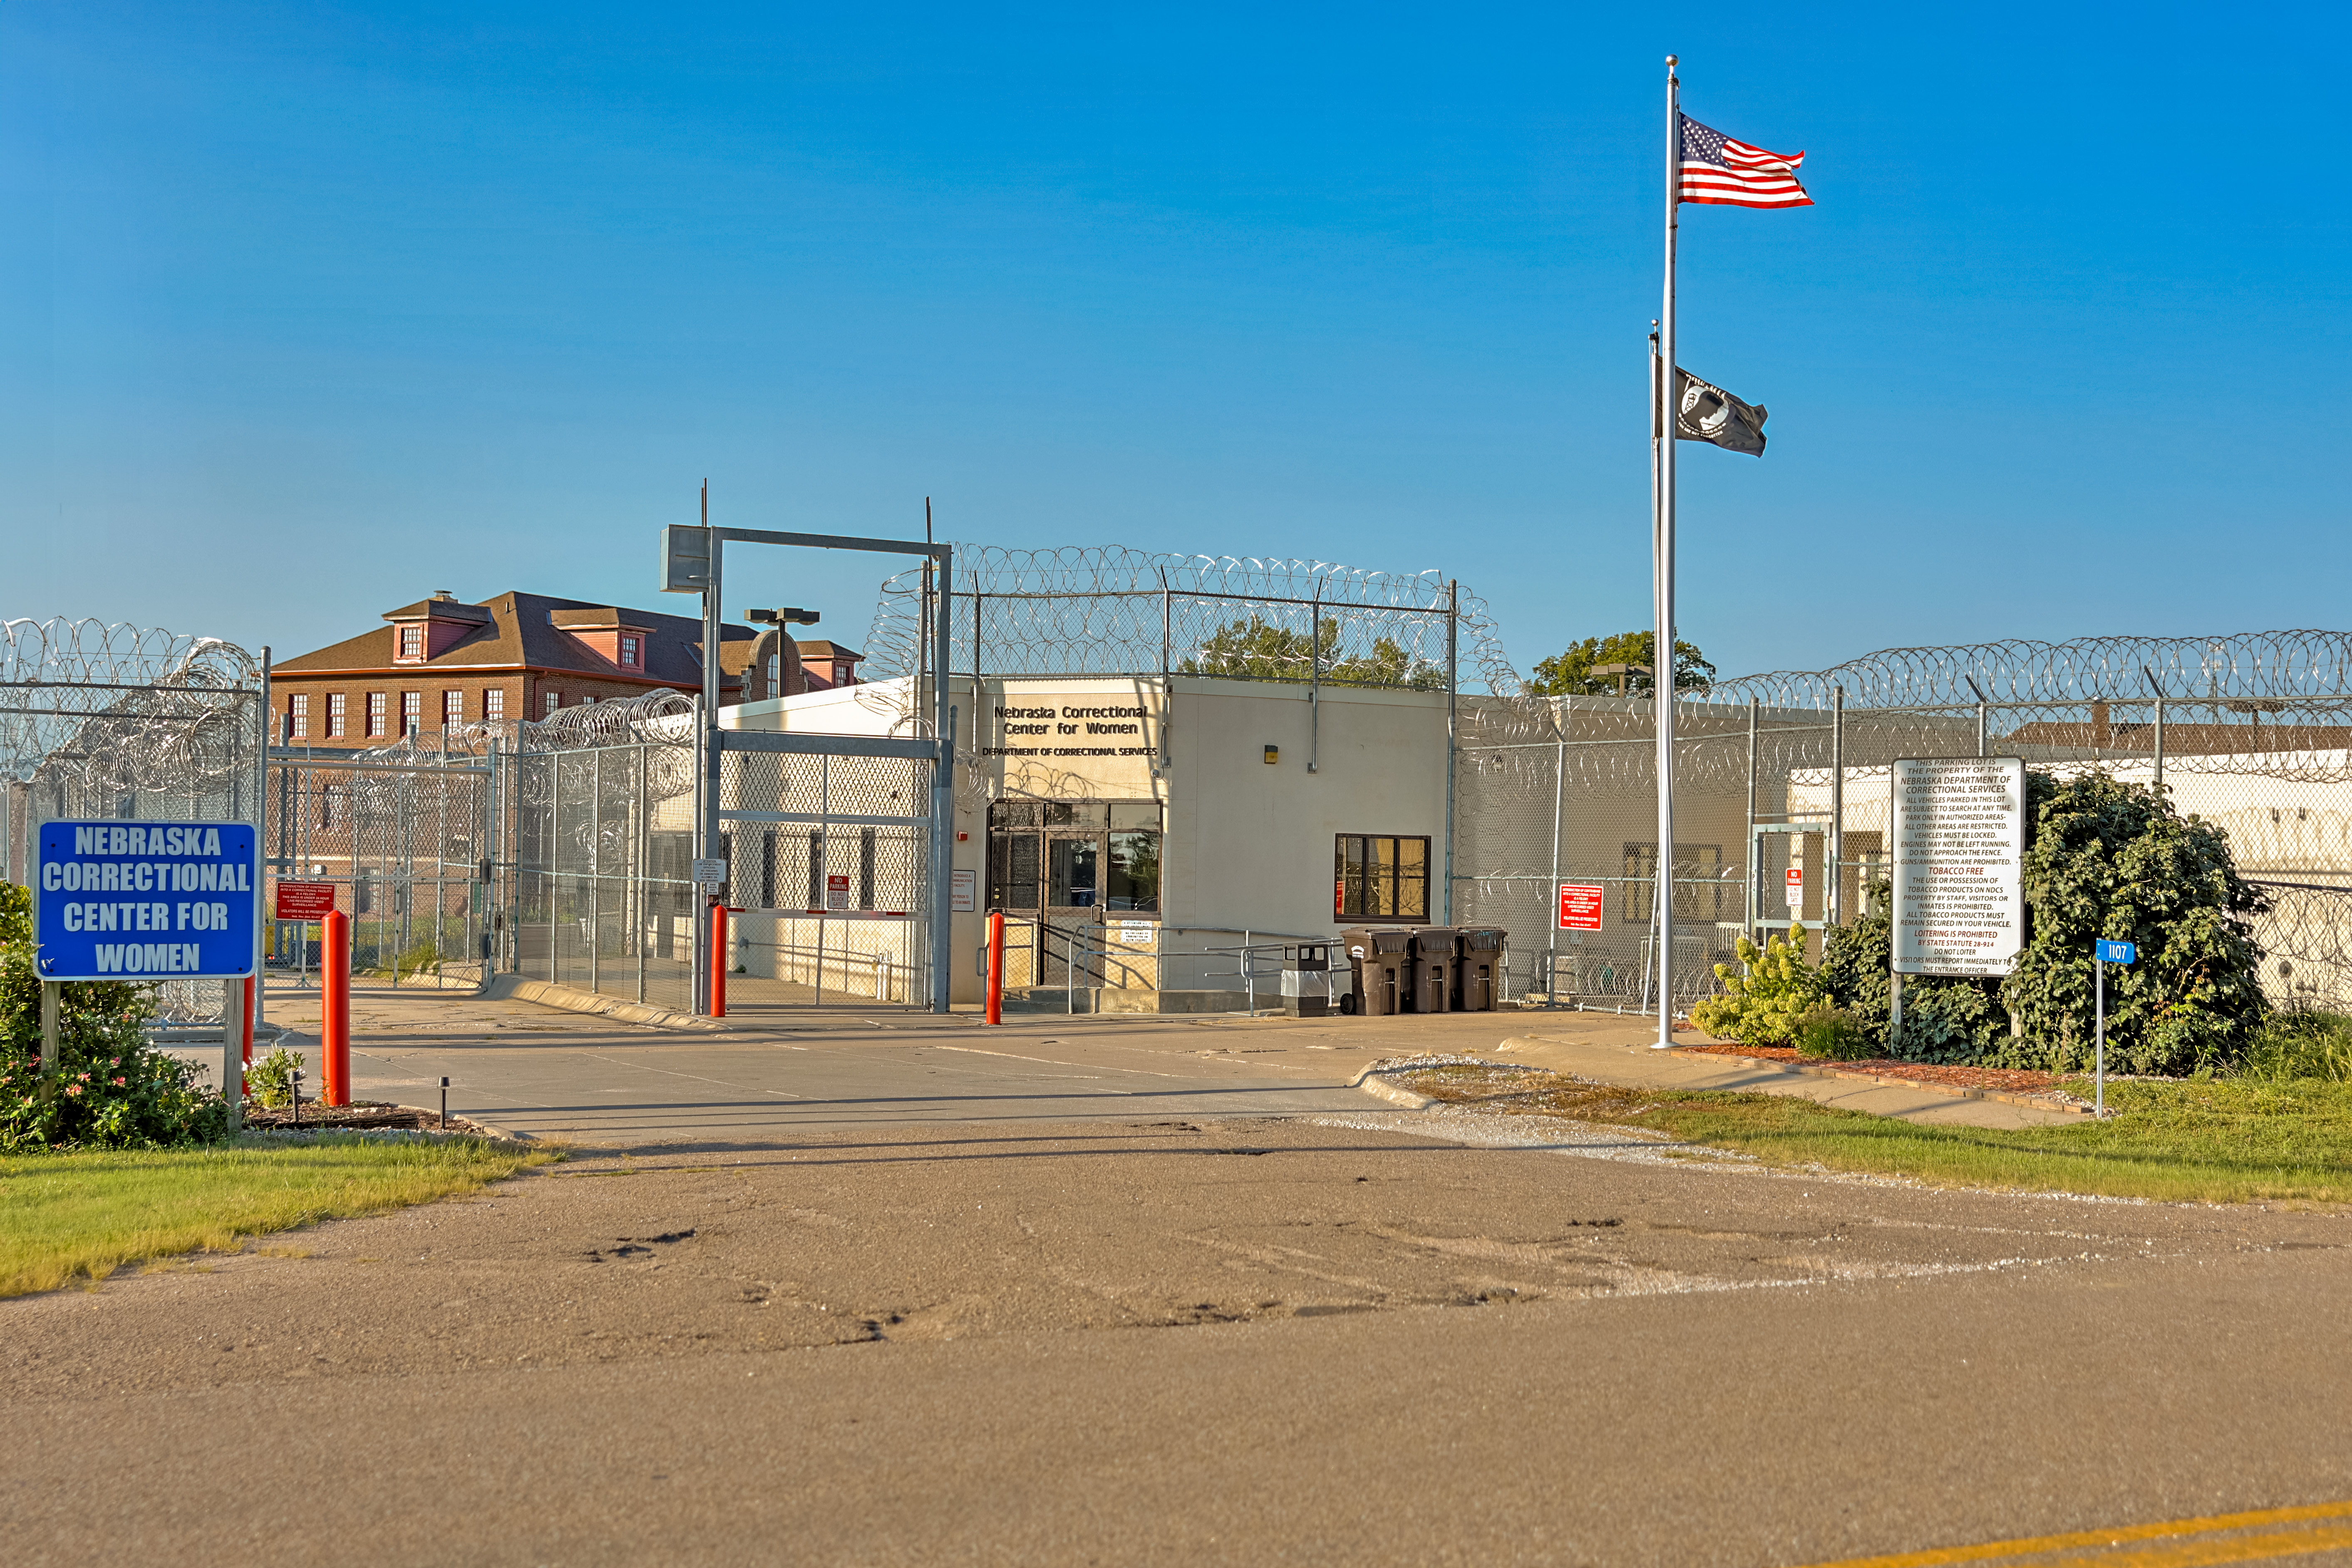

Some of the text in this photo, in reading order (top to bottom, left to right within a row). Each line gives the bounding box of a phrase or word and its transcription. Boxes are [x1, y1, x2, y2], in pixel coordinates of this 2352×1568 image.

[995, 705, 1148, 719] Nebraska Correctional
[1003, 722, 1139, 735] Center for Women
[983, 747, 1158, 757] DEPARTMENT OF CORRECTIONAL SERVICES
[75, 826, 221, 856] NEBRASKA
[43, 862, 250, 891] CORRECTIONAL
[64, 902, 228, 932] CENTER FOR
[95, 943, 200, 973] WOMEN
[2109, 944, 2127, 960] 1107
